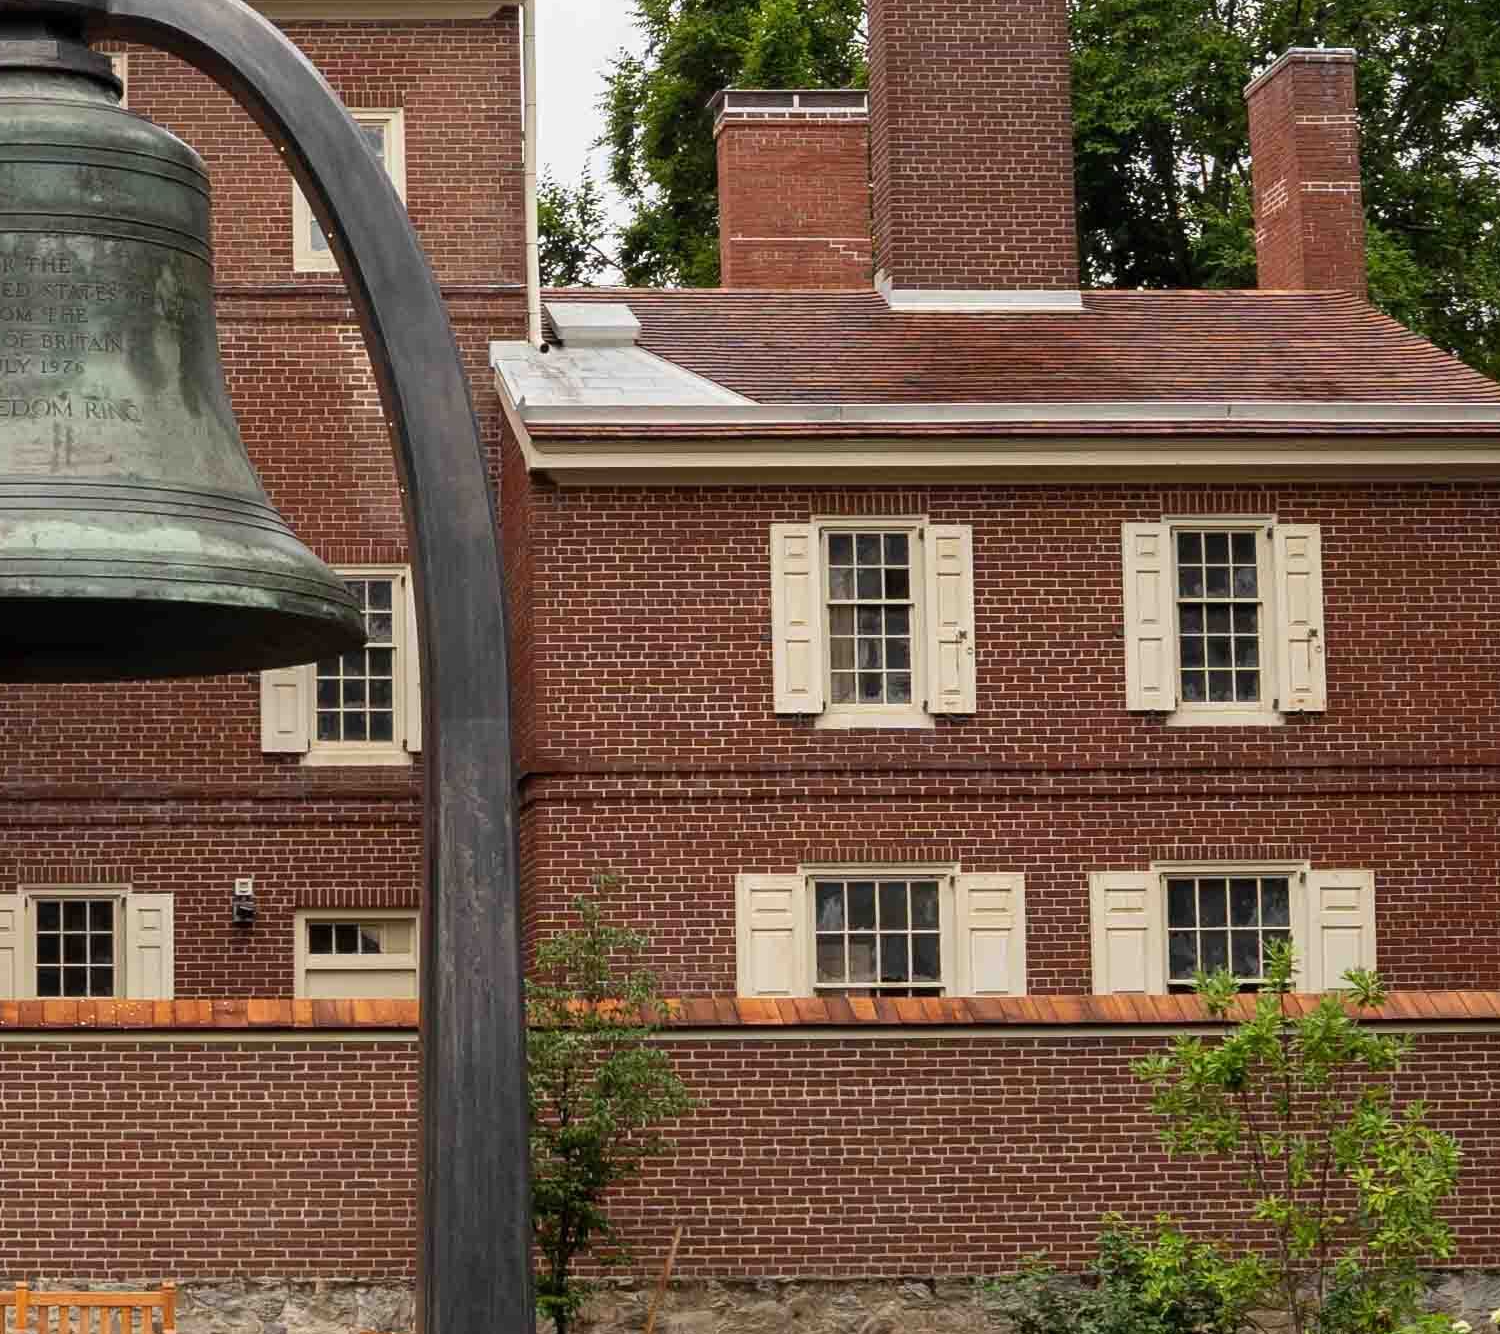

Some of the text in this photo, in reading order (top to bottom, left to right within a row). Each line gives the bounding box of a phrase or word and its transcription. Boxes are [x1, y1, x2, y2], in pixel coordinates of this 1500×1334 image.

[25, 257, 72, 273] THE
[41, 282, 115, 301] STATES
[40, 307, 88, 323] THE
[3, 333, 32, 349] OF
[40, 332, 122, 353] BRITAIN
[40, 359, 85, 374] 1976
[82, 400, 142, 422] RING
